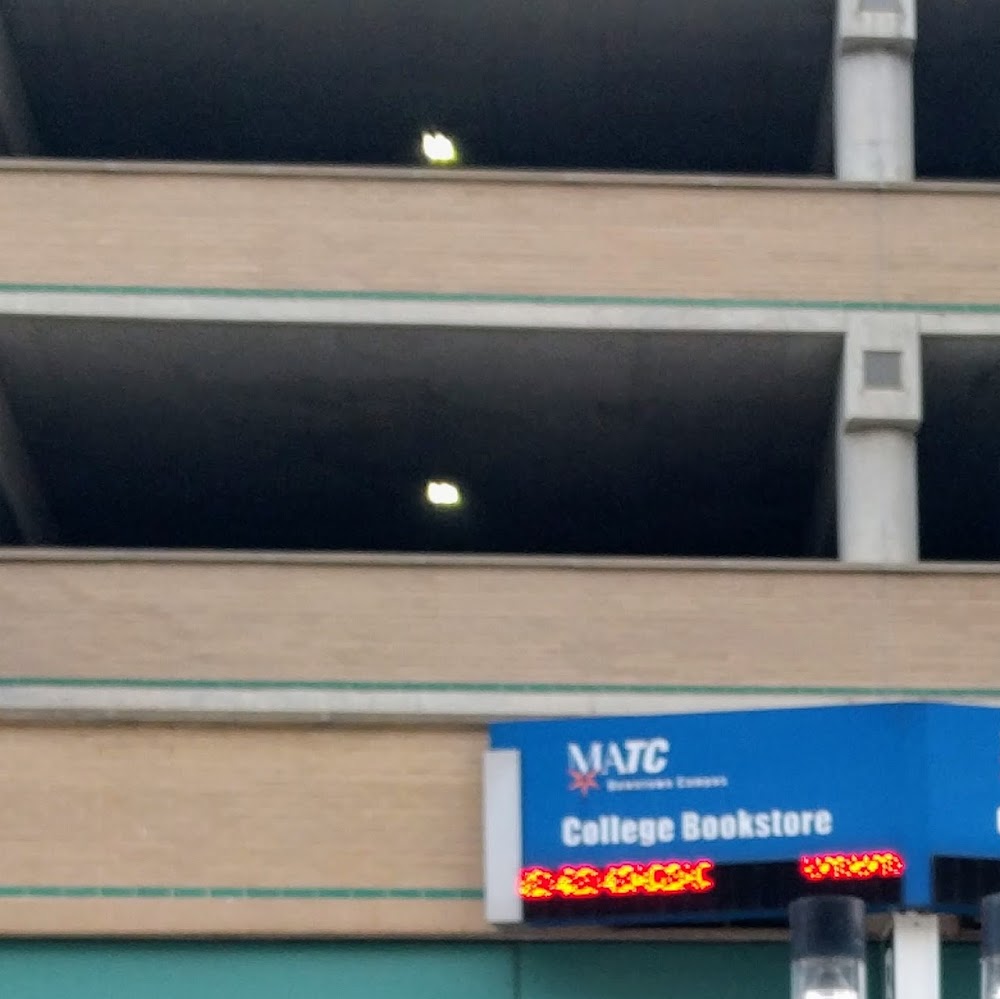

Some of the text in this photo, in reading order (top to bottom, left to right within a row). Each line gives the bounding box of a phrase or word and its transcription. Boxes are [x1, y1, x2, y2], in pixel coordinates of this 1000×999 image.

[568, 737, 670, 775] MATC
[561, 808, 833, 847] College Bookstore
